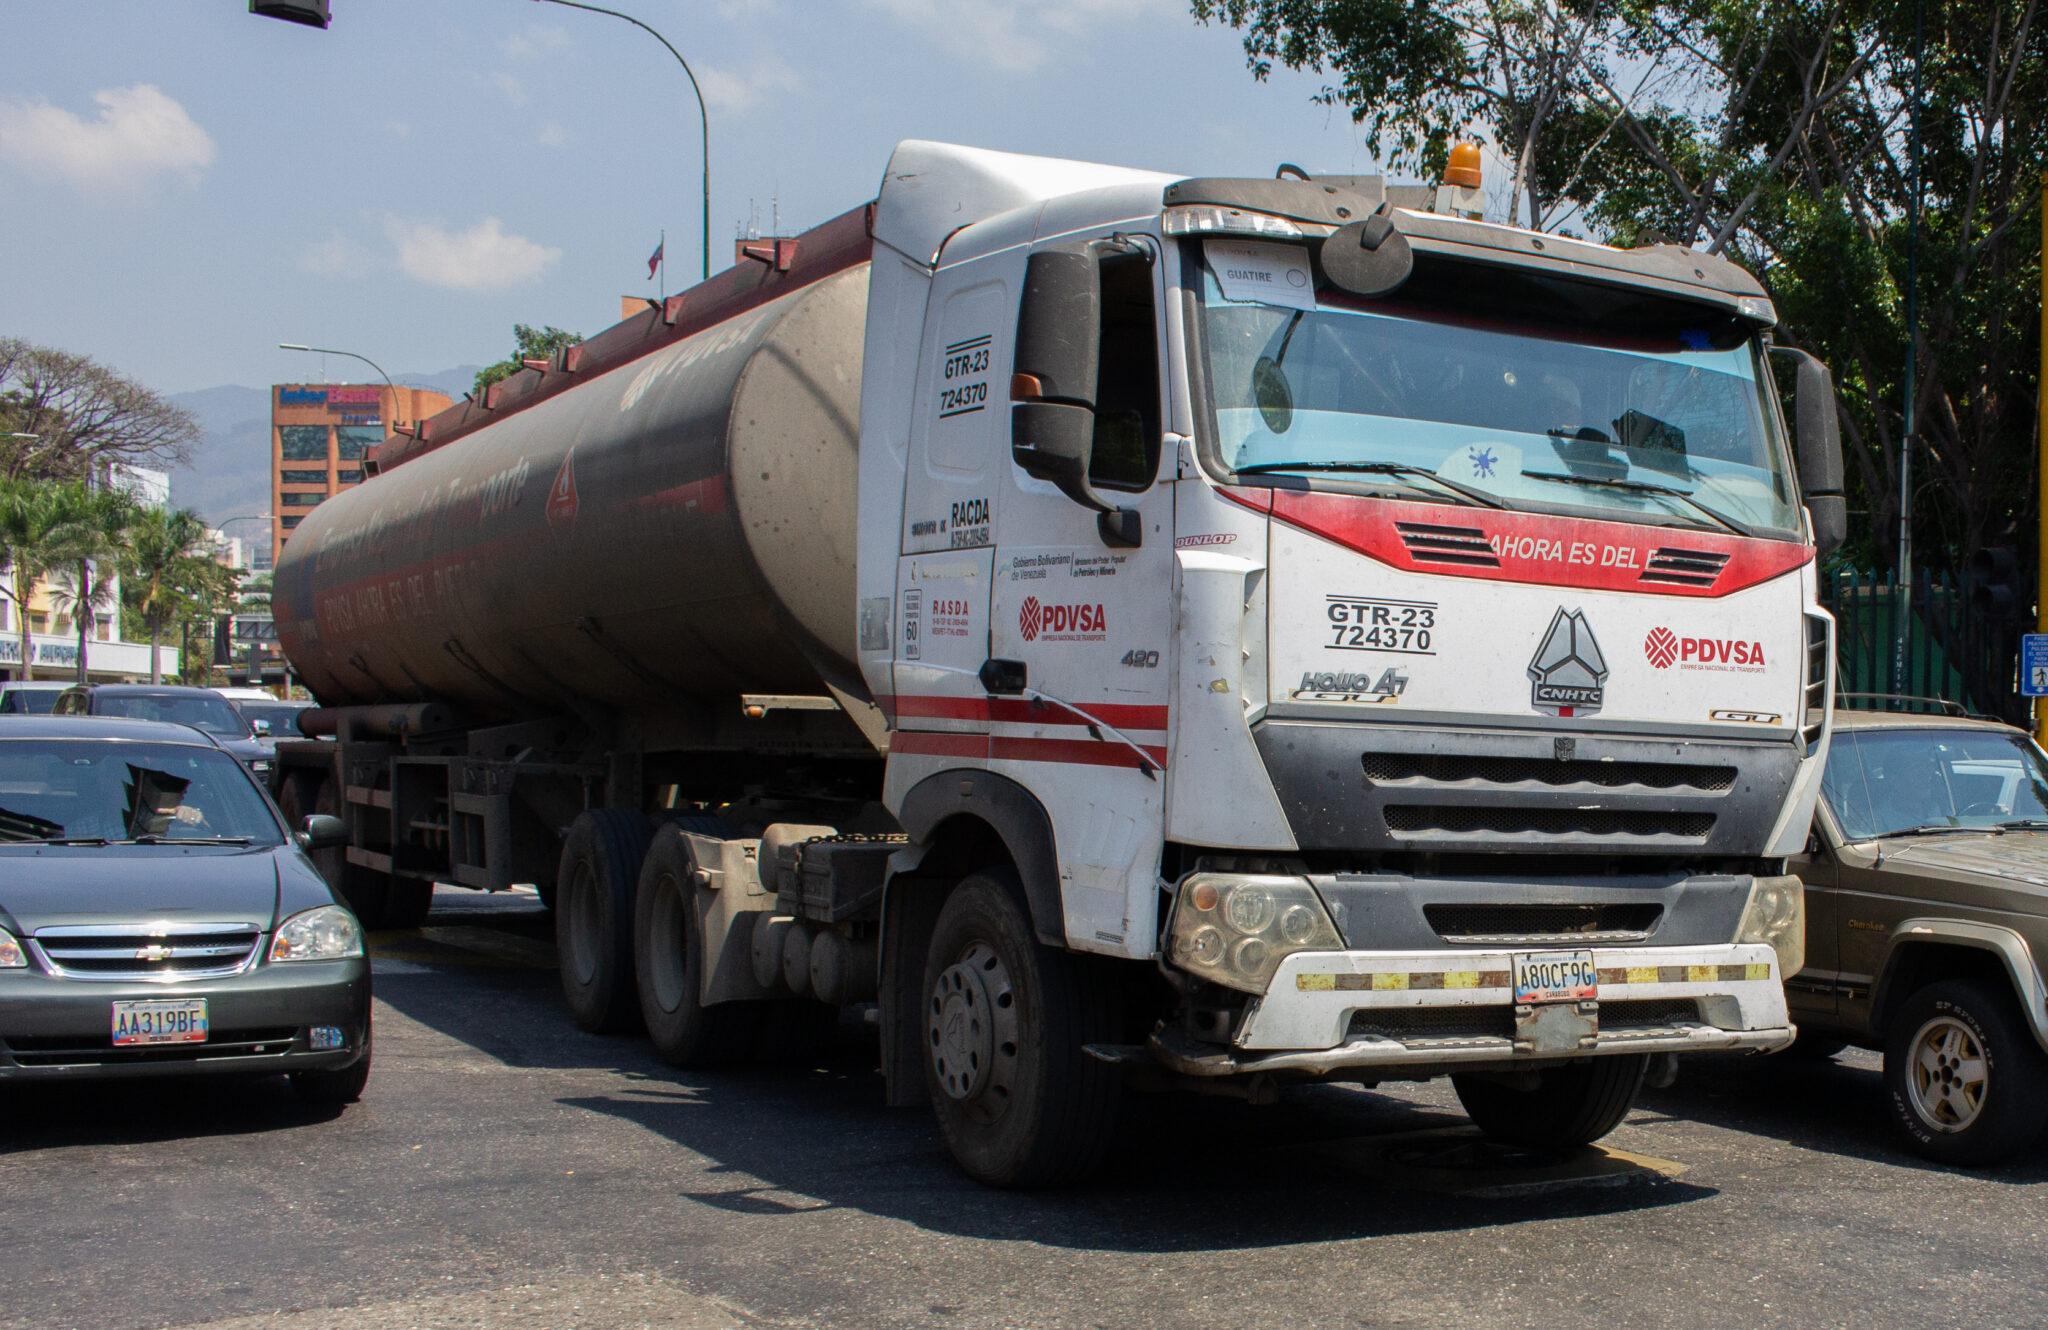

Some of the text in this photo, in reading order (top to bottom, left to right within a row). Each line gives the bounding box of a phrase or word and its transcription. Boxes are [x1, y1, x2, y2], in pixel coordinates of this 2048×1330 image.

[1227, 269, 1272, 282] GUATIRE
[945, 349, 990, 380] GTR-23
[940, 382, 988, 411] 724370
[951, 498, 990, 528] RACDA
[1175, 534, 1237, 548] DUNLOP
[1490, 534, 1562, 562] AHORA
[1568, 542, 1597, 565] ES
[1601, 545, 1640, 569] DEL
[1012, 553, 1070, 568] Gobierno Bolivariano
[1011, 569, 1046, 581] de Venezuela
[1042, 604, 1106, 632] PDVSA
[1327, 603, 1435, 629] GTR-23
[906, 621, 918, 641] 60
[1331, 624, 1431, 650] 724370
[1121, 650, 1159, 668] 420
[1681, 638, 1765, 665] PDVSA
[1300, 671, 1370, 692] HOWO
[1539, 688, 1601, 701] CNHTC
[1521, 962, 1592, 990] A80CF9G
[118, 1009, 200, 1035] AA319BF
[1953, 1005, 1987, 1042] SPORT
[1893, 1090, 1932, 1144] DUNLOP
